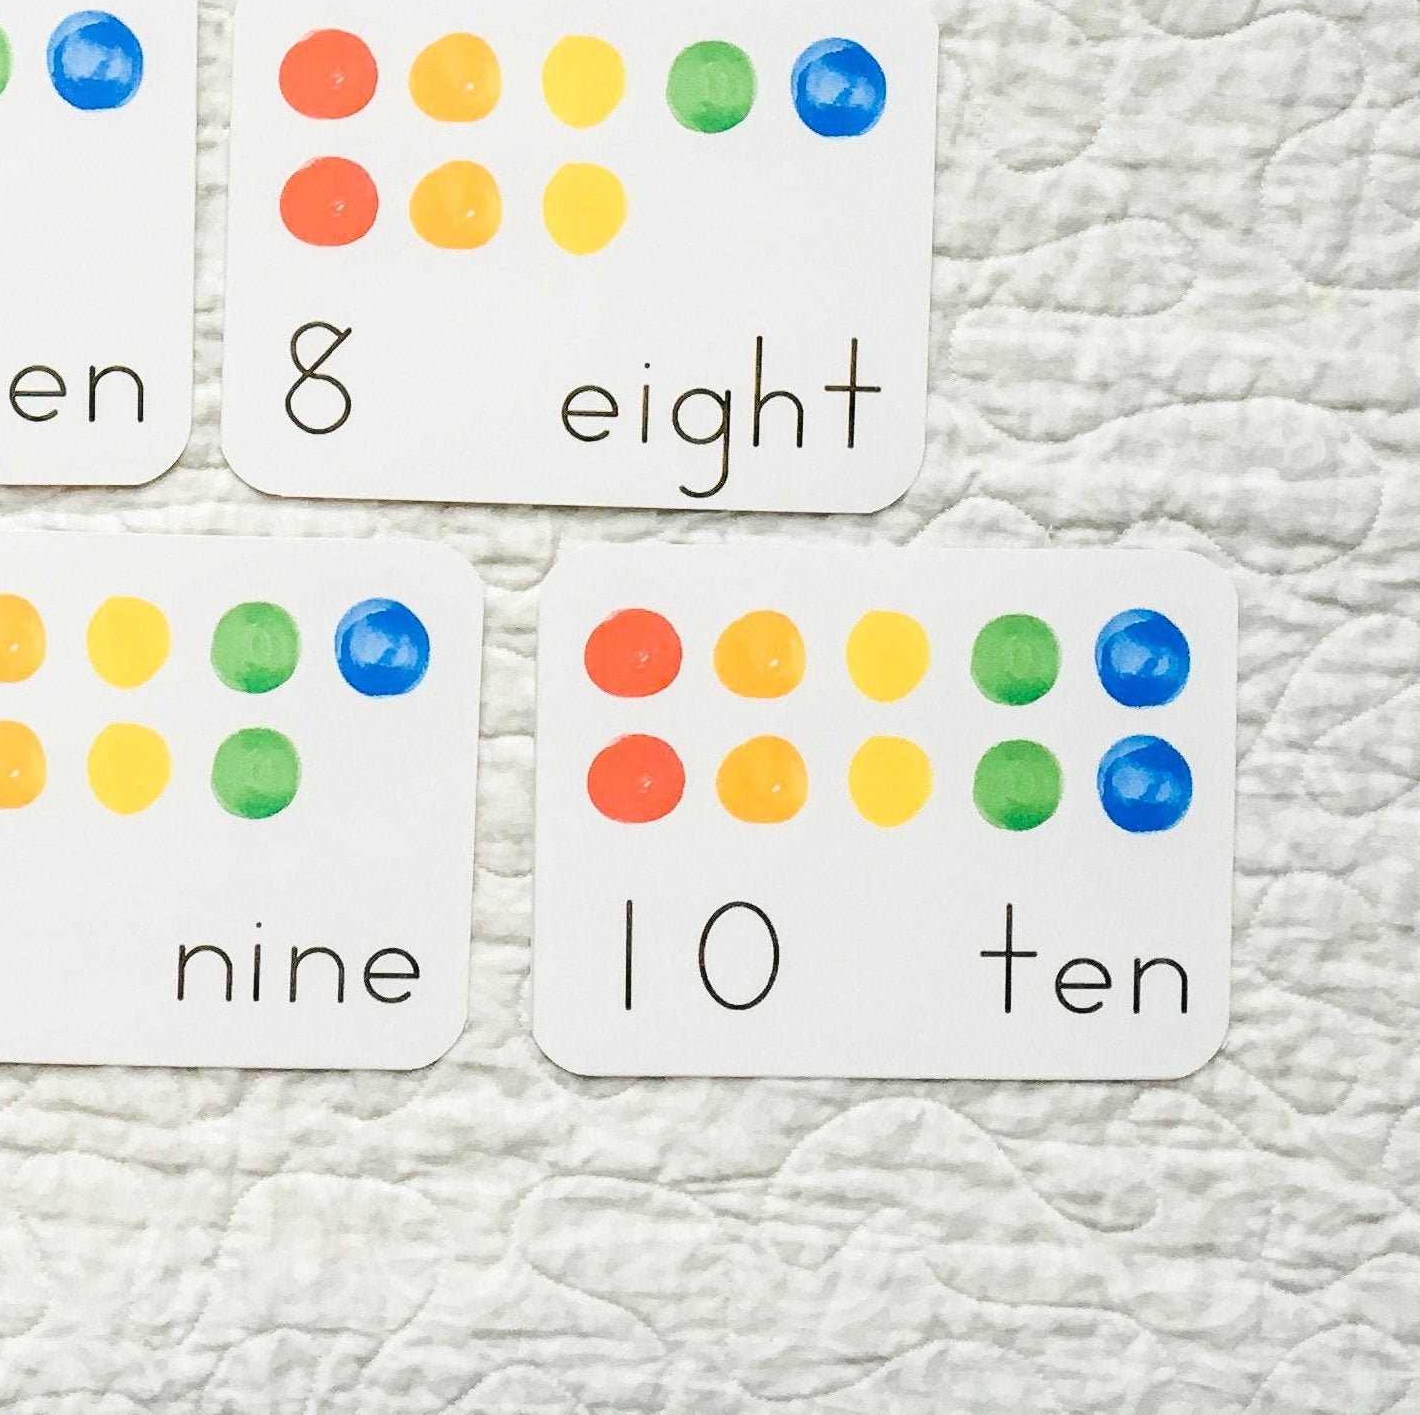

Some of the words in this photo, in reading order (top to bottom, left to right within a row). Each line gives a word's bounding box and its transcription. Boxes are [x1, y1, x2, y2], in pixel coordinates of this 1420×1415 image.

[284, 320, 353, 436] 8
[560, 335, 882, 499] eight
[176, 921, 421, 1005] nine
[624, 899, 781, 1011] 10
[979, 902, 1189, 1015] ten
